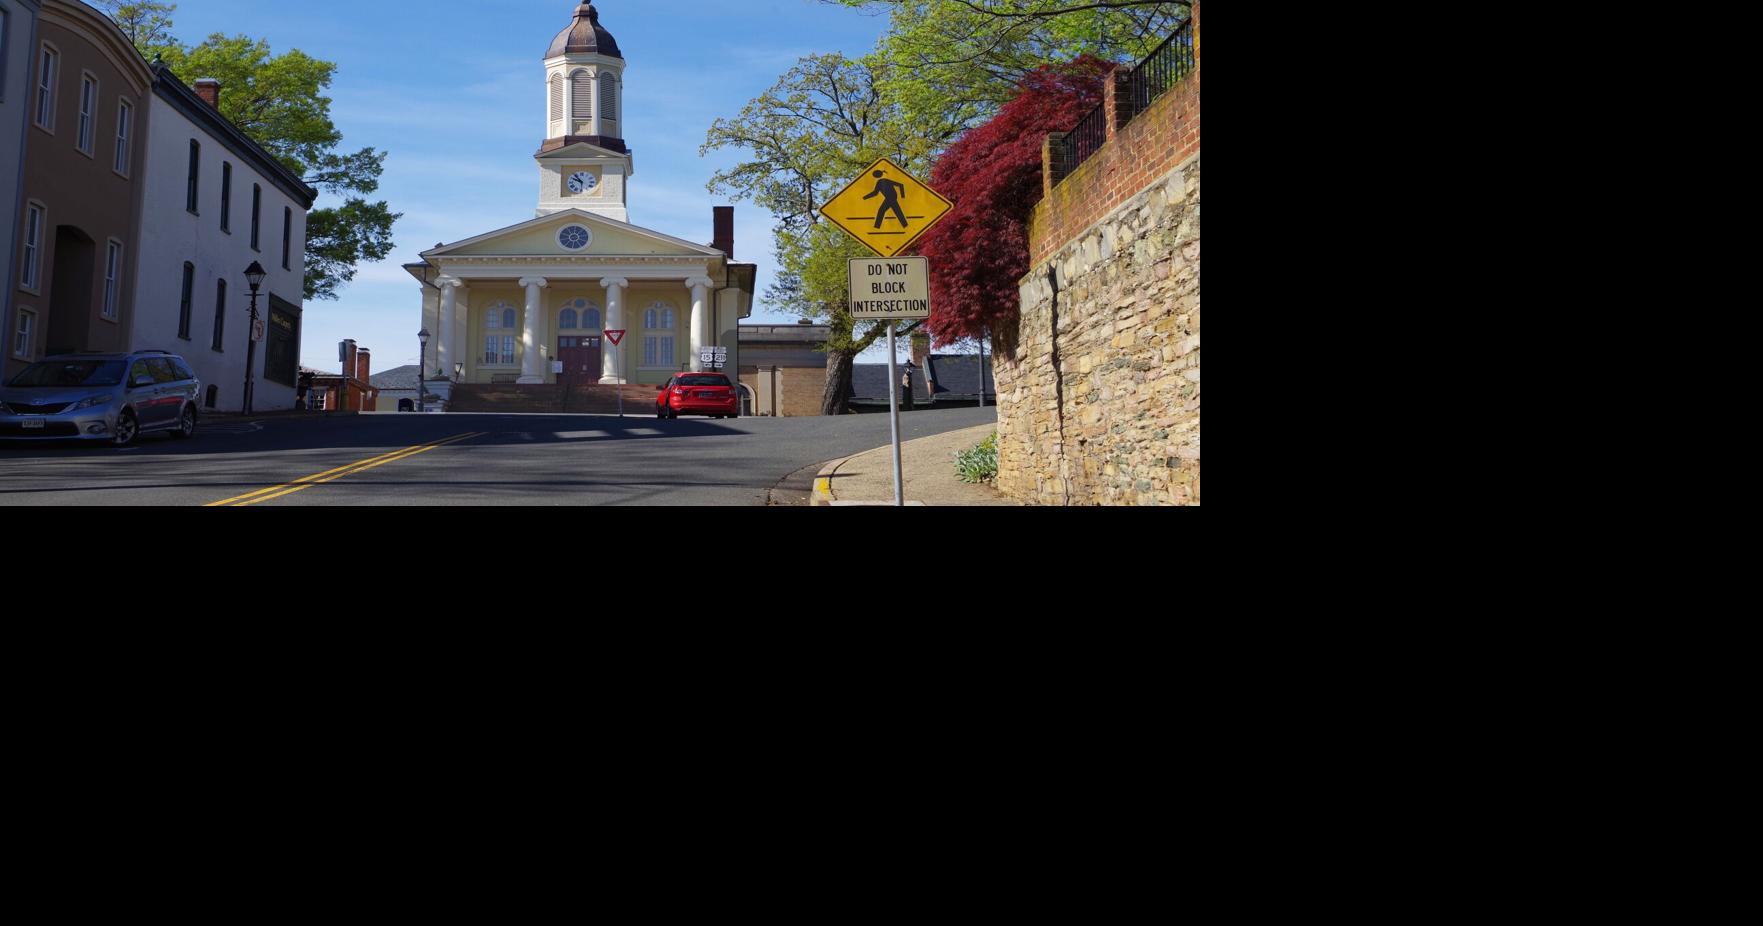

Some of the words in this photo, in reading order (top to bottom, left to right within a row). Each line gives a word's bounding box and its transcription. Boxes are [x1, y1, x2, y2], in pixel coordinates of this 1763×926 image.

[868, 264, 882, 276] DO
[888, 263, 908, 275] NOT
[872, 282, 906, 294] BLOCK
[853, 299, 927, 313] INTERSECTION
